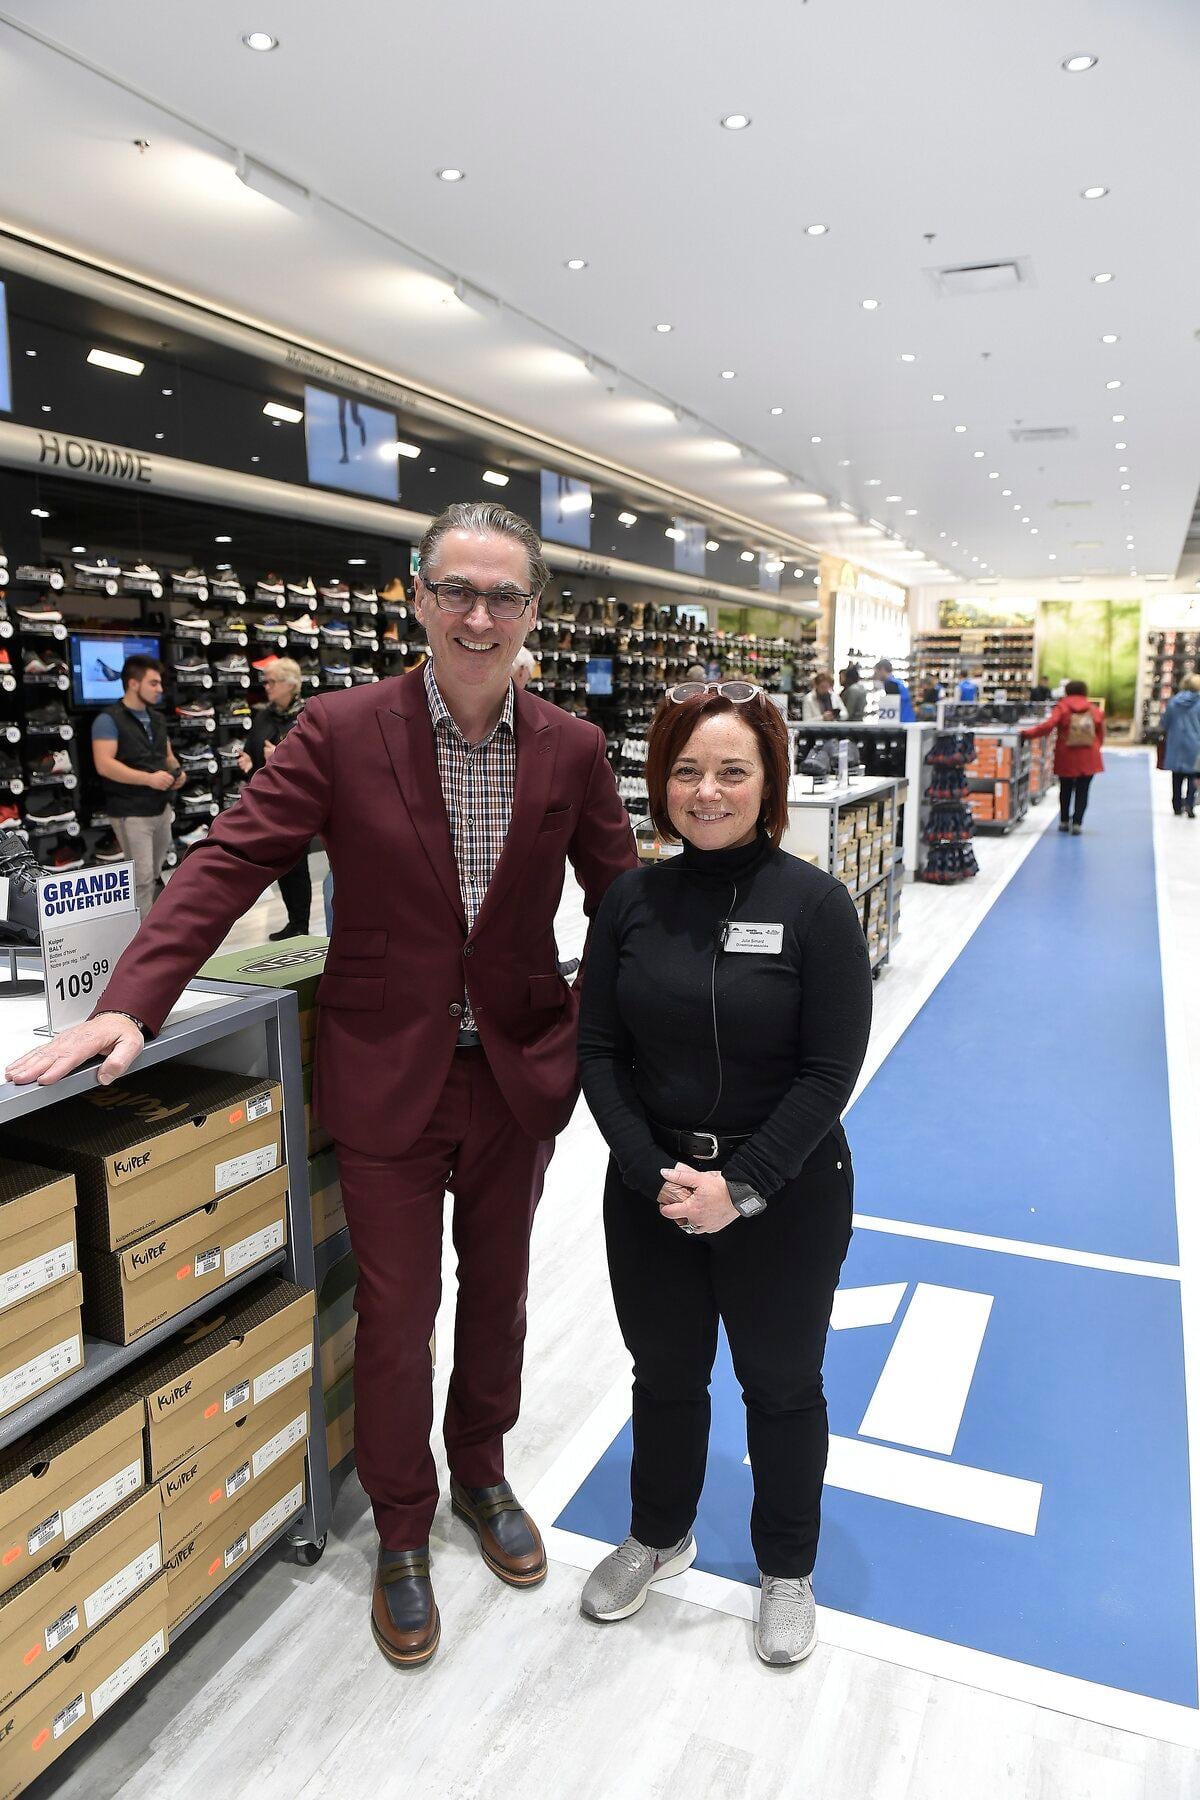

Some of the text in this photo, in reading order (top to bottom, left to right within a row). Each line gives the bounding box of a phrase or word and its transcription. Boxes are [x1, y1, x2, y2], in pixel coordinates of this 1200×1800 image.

[38, 432, 152, 484] HOMME
[43, 869, 130, 903] GRANDE
[44, 887, 131, 918] OUVERTURE
[48, 937, 65, 947] Kuiper
[247, 949, 329, 972] EEN
[115, 1219, 157, 1243] kuipershoes.com
[128, 1310, 168, 1338] kuipershoes.com
[156, 1445, 195, 1475] kuipershoes.com
[130, 1477, 137, 1486] 10
[154, 1646, 161, 1656] 10
